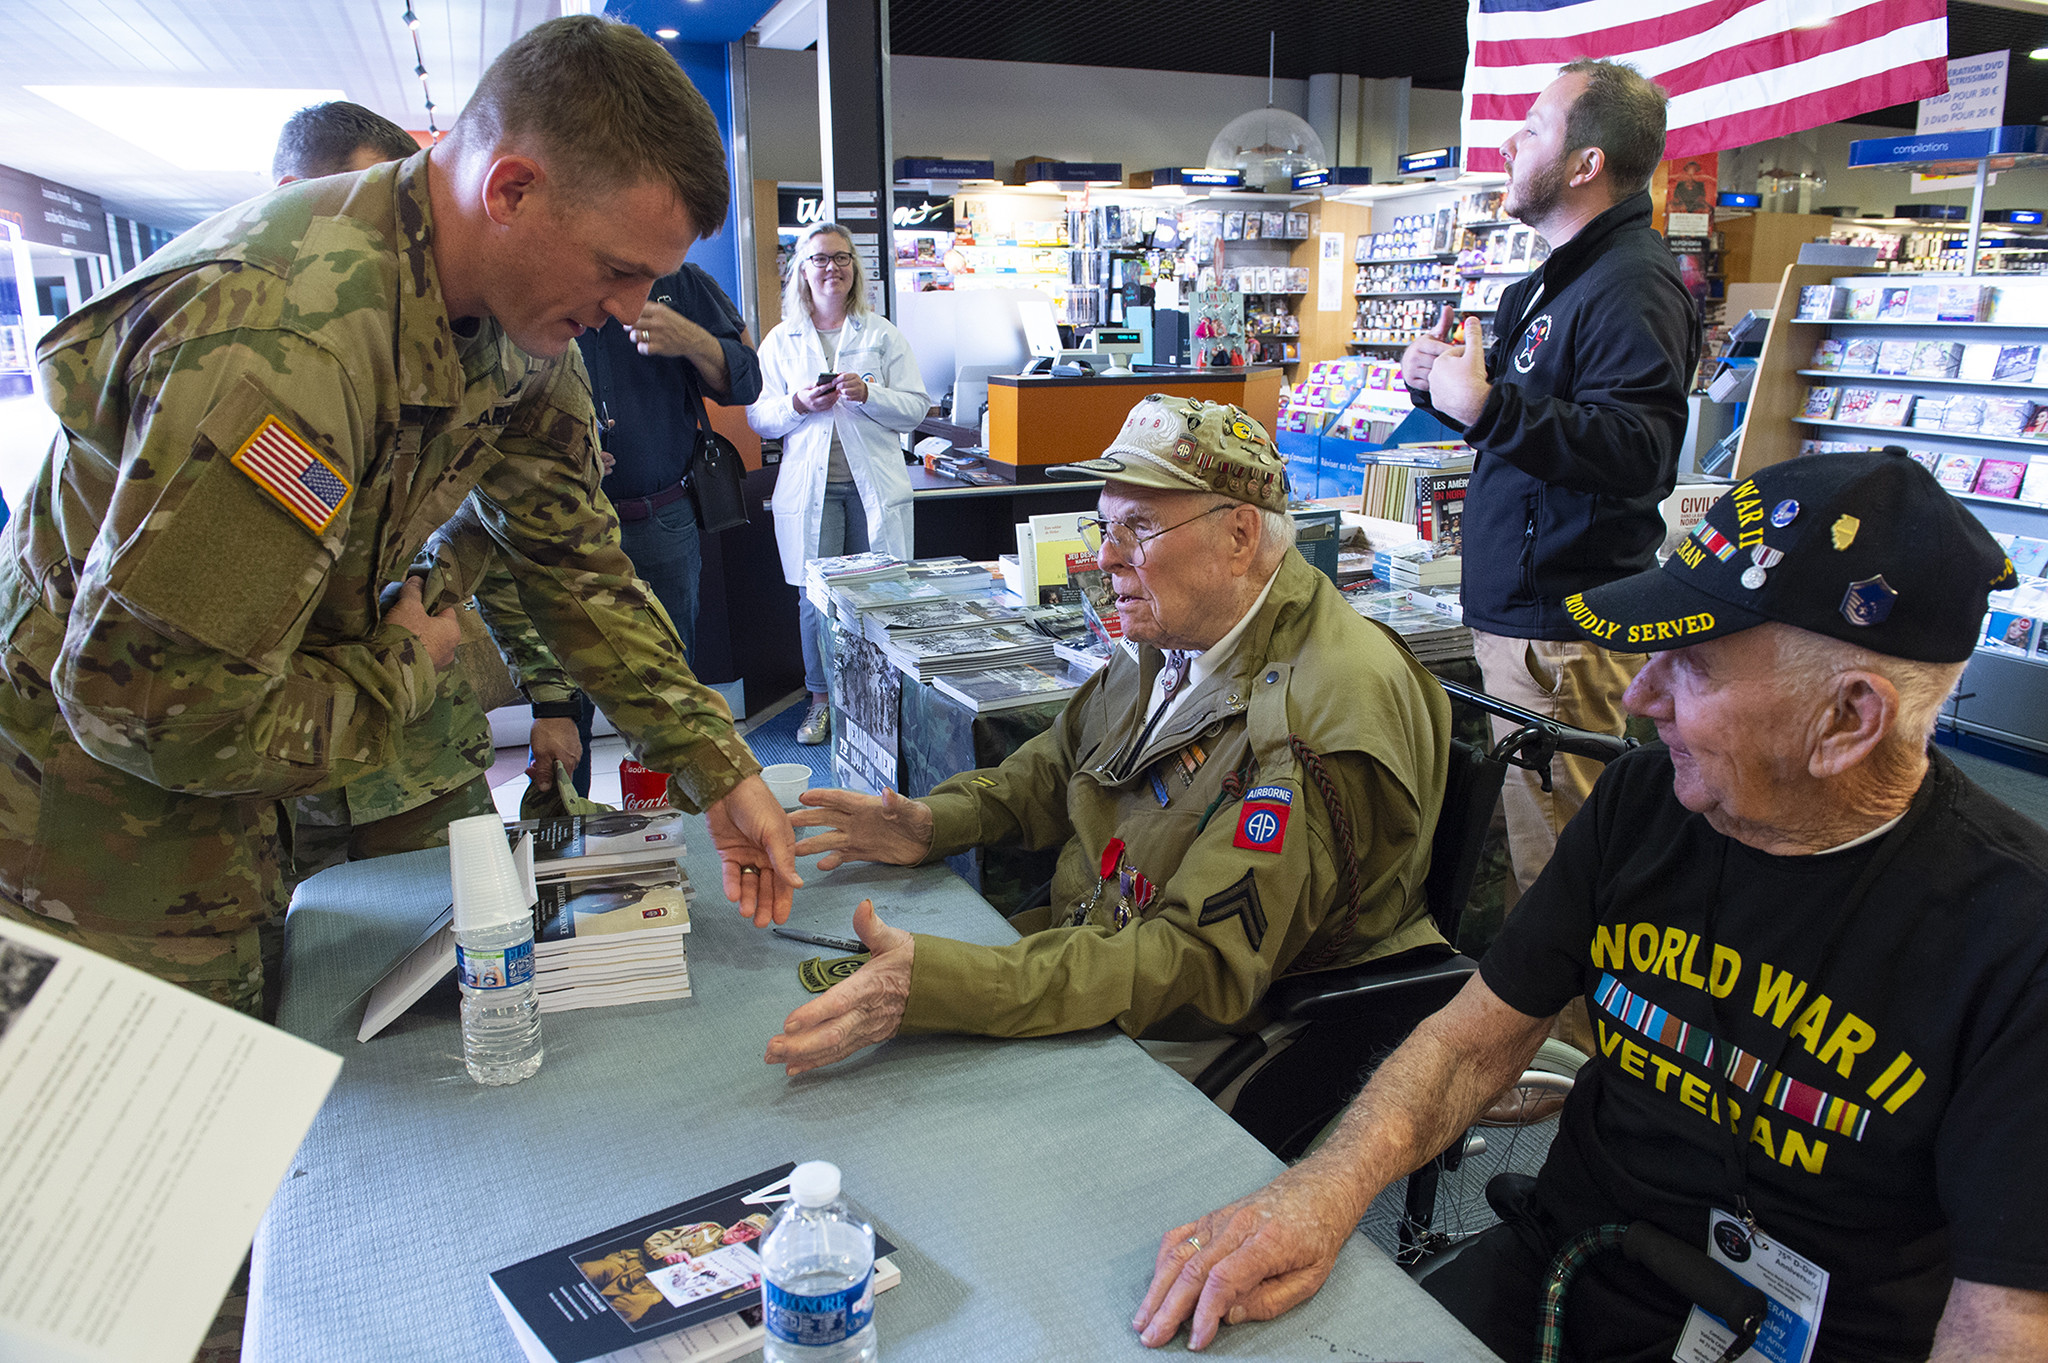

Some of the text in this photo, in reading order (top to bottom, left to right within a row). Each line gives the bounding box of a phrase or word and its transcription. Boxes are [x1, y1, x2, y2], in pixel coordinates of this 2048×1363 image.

[1984, 60, 2004, 71] DVD
[1953, 89, 1978, 101] POUR
[1950, 102, 1966, 112] OU
[1951, 110, 1976, 121] POUR
[1892, 141, 1949, 155] compilations
[1433, 481, 1446, 490] LES
[1434, 490, 1444, 500] EN
[1731, 479, 1764, 549] WAR II
[1067, 552, 1079, 560] JEU
[1627, 612, 1715, 643] SERVED
[1247, 786, 1291, 802] AIRBORNE
[1590, 922, 1927, 1115] WORLD WAR II
[1597, 1018, 1829, 1175] VETERAN
[1775, 1259, 1819, 1290] Anniversary
[1793, 1259, 1818, 1279] D-Day
[1767, 1301, 1793, 1324] ERAN
[1764, 1318, 1786, 1340] eley
[1766, 1335, 1787, 1353] Army
